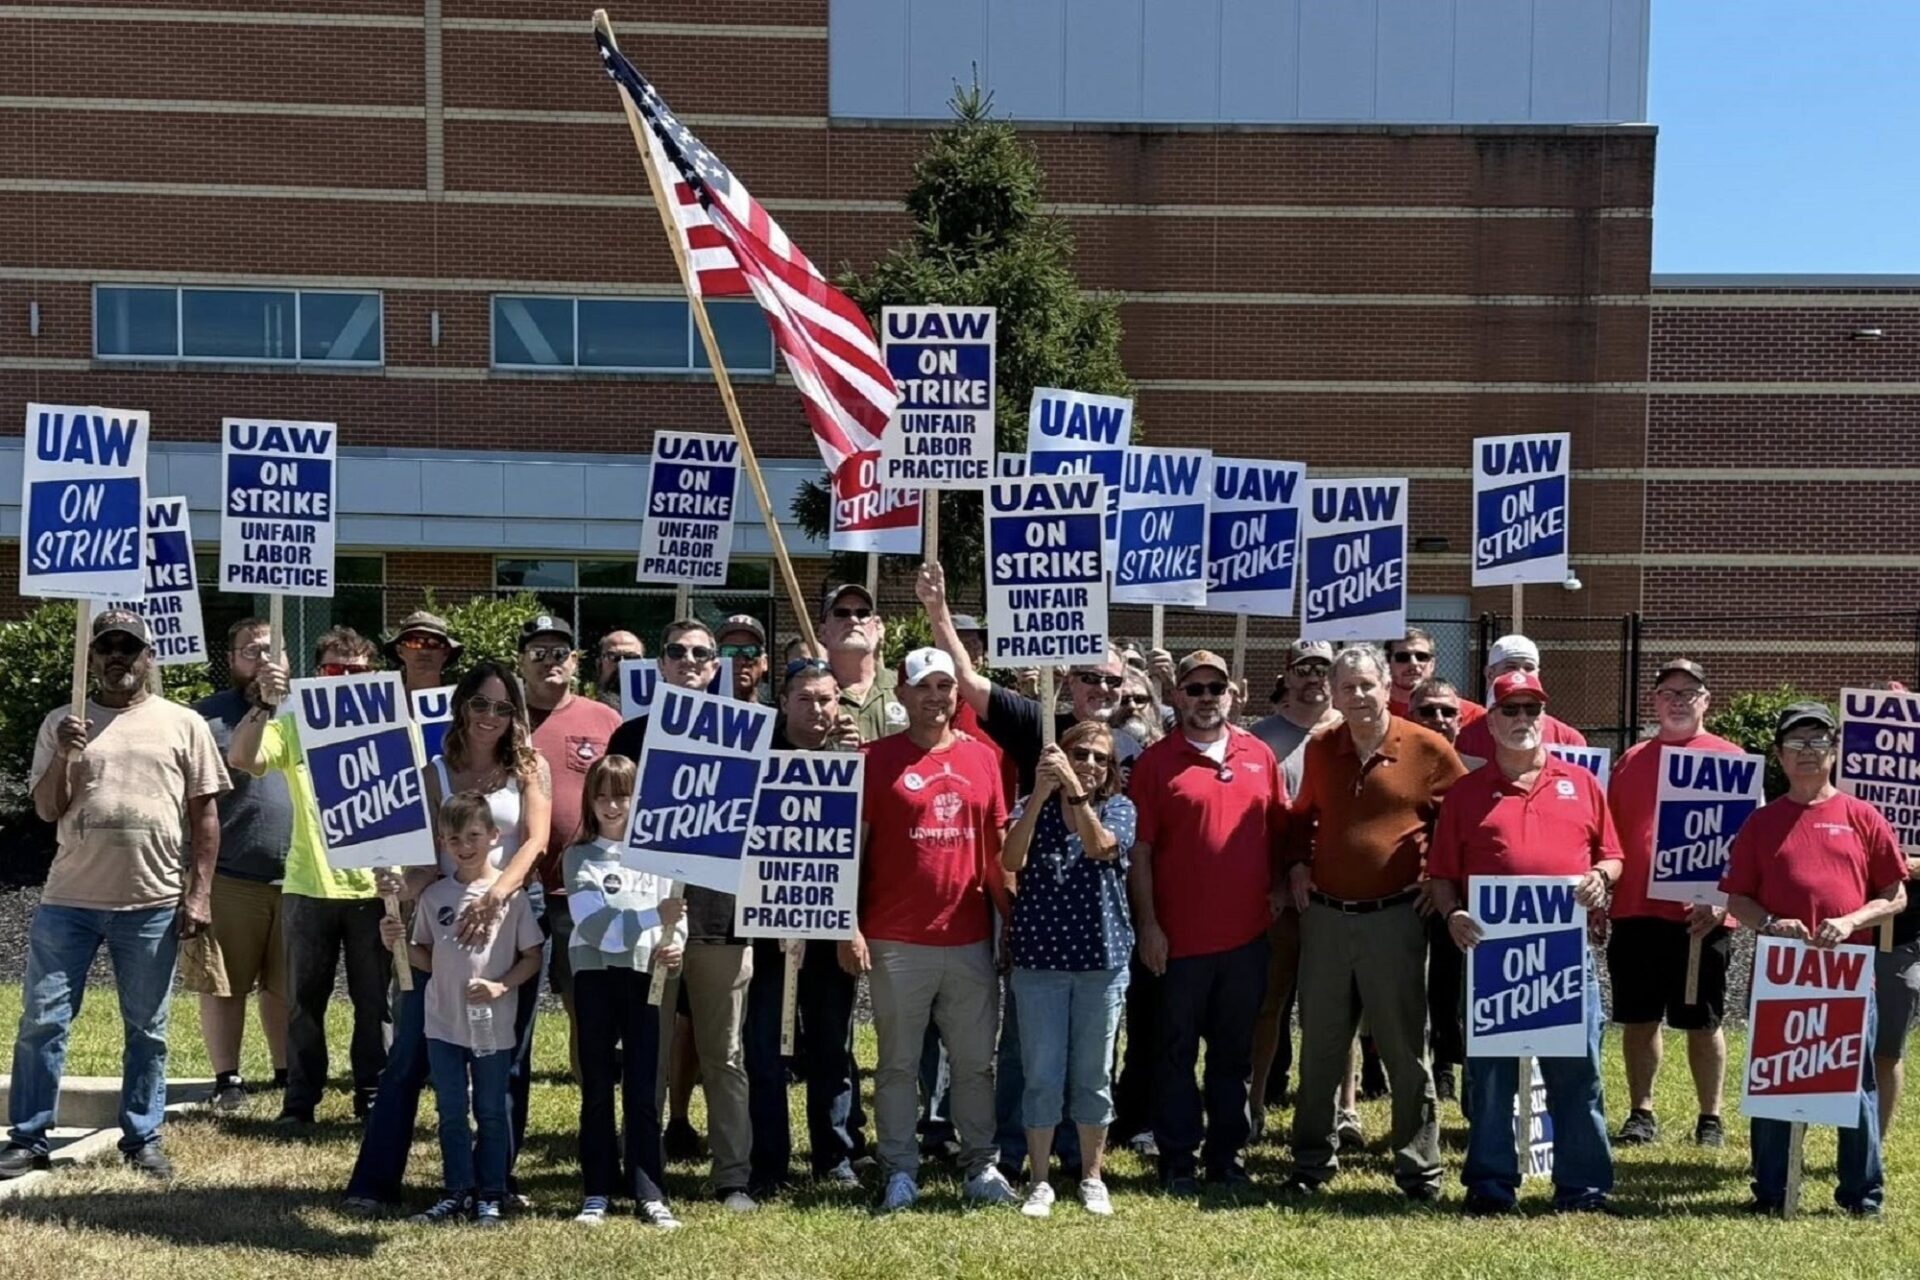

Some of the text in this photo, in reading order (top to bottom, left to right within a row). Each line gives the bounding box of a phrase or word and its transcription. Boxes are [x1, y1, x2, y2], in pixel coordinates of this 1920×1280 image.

[888, 313, 990, 340] UAW
[918, 349, 957, 374] ON
[897, 379, 987, 406] STRIKE
[901, 415, 976, 433] UNFAIR
[1039, 398, 1124, 444] UAW
[37, 412, 138, 467] UAW
[229, 424, 332, 454] UAW
[658, 437, 739, 462] UAW
[905, 437, 972, 456] LABOR
[888, 459, 989, 479] PRACTICE
[1482, 440, 1562, 476] UAW
[260, 462, 298, 486] ON
[678, 469, 711, 491] ON
[1124, 453, 1202, 496] UAW
[1215, 466, 1298, 503] UAW
[60, 484, 105, 523] ON
[230, 489, 329, 516] STRIKE
[652, 492, 731, 516] STRIKE
[836, 488, 919, 528] STRIKE
[990, 481, 1099, 512] UAW
[1312, 486, 1400, 523] UAW
[1501, 485, 1535, 523] ON
[241, 522, 316, 544] UNFAIR
[658, 521, 719, 540] UNFAIR
[1025, 520, 1066, 547] ON
[1141, 511, 1175, 543] ON
[1231, 513, 1267, 550] ON
[1478, 505, 1564, 567] STRIKE
[33, 526, 138, 569] STRIKE
[244, 544, 311, 565] LABOR
[658, 539, 713, 559] LABOR
[1120, 544, 1201, 581] STRIKE
[1333, 534, 1370, 575] ON
[227, 564, 328, 587] PRACTICE
[643, 557, 723, 577] PRACTICE
[995, 551, 1098, 578] STRIKE
[1206, 539, 1295, 590] STRIKE
[1008, 588, 1088, 609] UNFAIR
[1308, 558, 1404, 619] STRIKE
[1013, 612, 1084, 632] LABOR
[997, 635, 1102, 656] PRACTICE
[301, 681, 396, 730] UAW
[660, 692, 767, 752] UAW
[1875, 728, 1915, 754] ON
[338, 740, 380, 790] ON
[672, 761, 722, 800] ON
[1668, 754, 1757, 794] UAW
[1845, 752, 1920, 780] STRIK
[322, 766, 421, 845] STRIKE
[780, 796, 822, 822] ON
[1855, 783, 1920, 806] UNFAI
[633, 798, 752, 845] STRIKE
[1684, 804, 1724, 840] ON
[749, 826, 852, 854] STRIKE
[759, 861, 840, 883] UNFAIR
[1656, 834, 1736, 880] STRIK
[761, 885, 834, 907] LABOR
[1480, 885, 1576, 924] UAW
[743, 907, 851, 930] PRACTICE
[1502, 938, 1546, 982] ON
[1766, 945, 1866, 990] UAW
[1474, 965, 1584, 1034] STRIKE
[1783, 1003, 1829, 1044] ON
[1750, 1032, 1862, 1091] STRIKE
